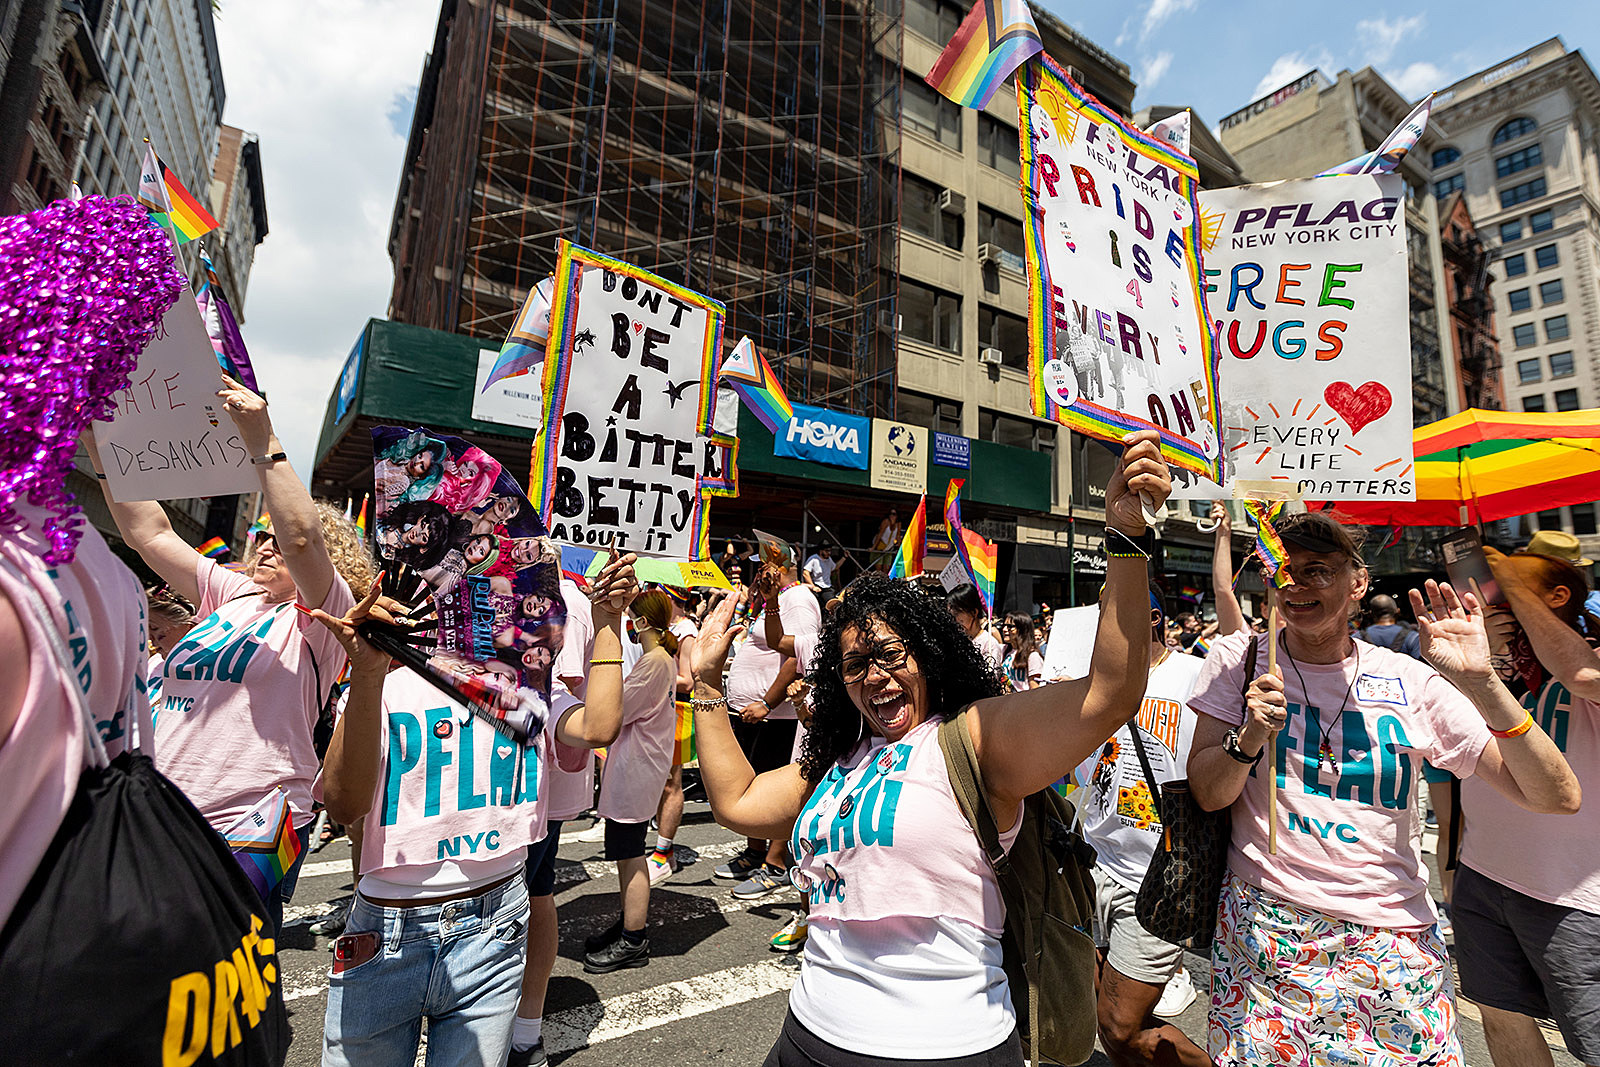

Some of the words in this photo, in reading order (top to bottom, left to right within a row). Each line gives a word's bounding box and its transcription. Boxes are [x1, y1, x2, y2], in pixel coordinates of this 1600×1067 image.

[1087, 145, 1117, 174] NEW
[1122, 168, 1160, 202] YORK
[1039, 153, 1185, 268] PRIDE
[1232, 197, 1398, 234] PFLAG
[1232, 232, 1276, 250] NEW
[1285, 229, 1340, 245] YORK
[1350, 223, 1398, 240] CITY
[602, 269, 692, 329] DONT
[611, 312, 671, 375] BE
[1053, 284, 1161, 366] EVERY
[612, 374, 641, 419] A
[1147, 379, 1208, 437] ONE
[786, 417, 859, 454] HOKA
[1253, 425, 1340, 447] EVERY
[1280, 453, 1343, 470] LIFE
[552, 467, 696, 532] BETTY
[1297, 479, 1411, 495] MATTERS
[551, 523, 630, 548] ABOUT
[165, 695, 195, 713] NYC
[1133, 698, 1180, 755] WER
[380, 706, 538, 827] PFLAG
[1250, 702, 1413, 810] FLAG
[437, 829, 500, 860] NYC
[1288, 812, 1360, 844] NYC
